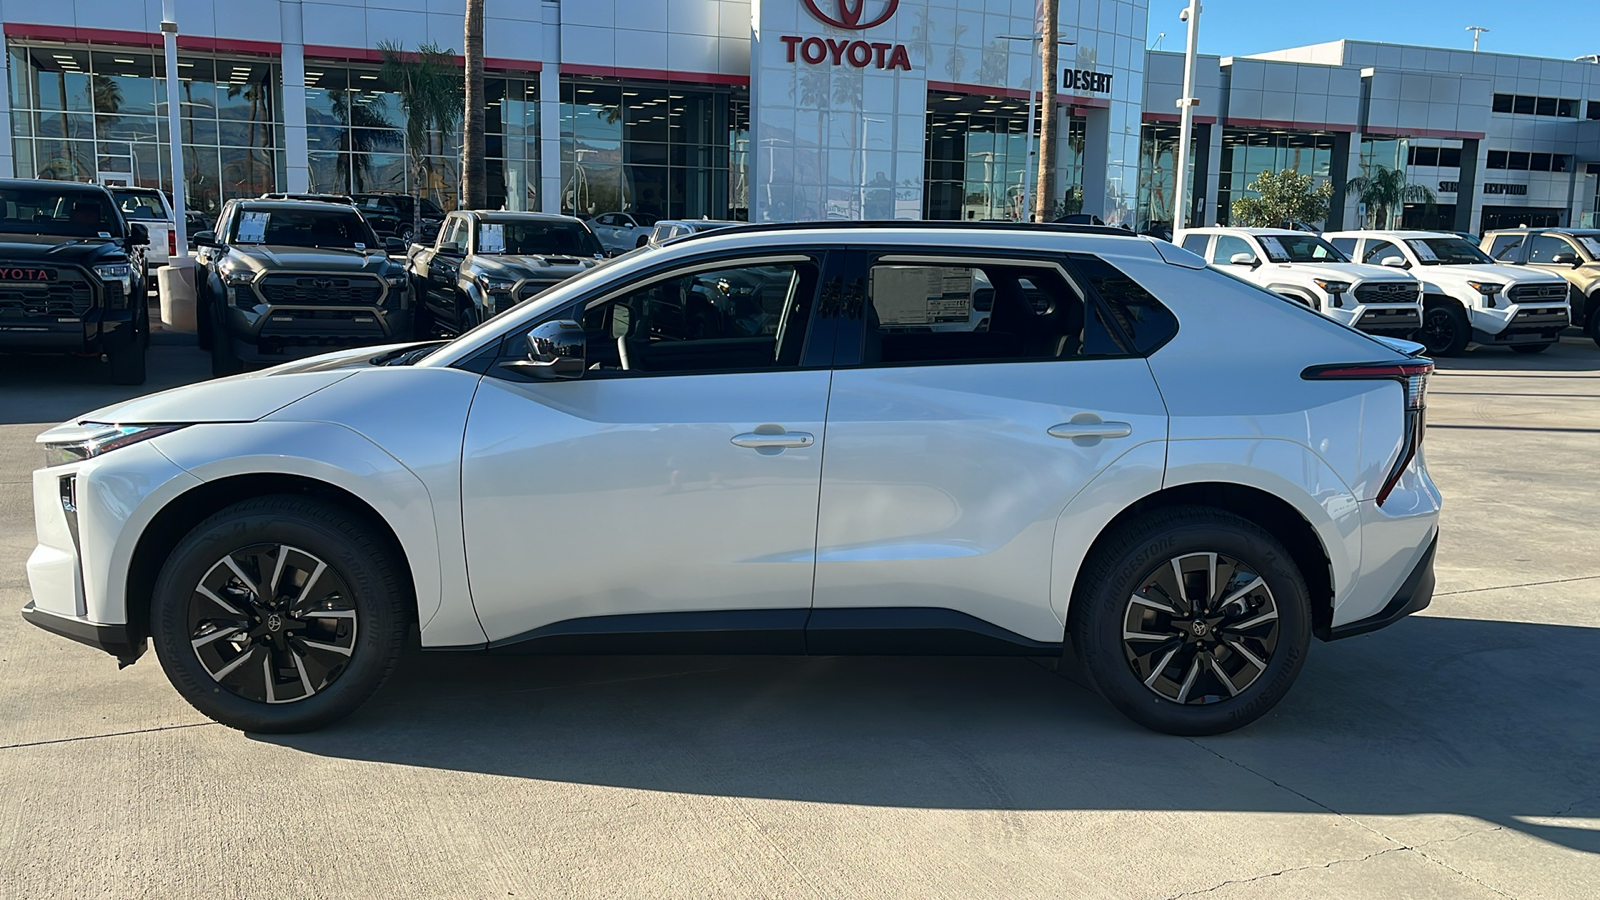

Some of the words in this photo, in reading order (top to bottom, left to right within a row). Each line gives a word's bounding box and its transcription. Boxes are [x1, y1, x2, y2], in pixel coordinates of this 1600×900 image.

[780, 35, 912, 70] TOYOTA
[1063, 68, 1113, 94] DESERT
[337, 549, 382, 652] BRIDGESTONE
[1102, 535, 1178, 614] BRIDGESTONE
[1227, 644, 1301, 721] BRIDGESTONE
